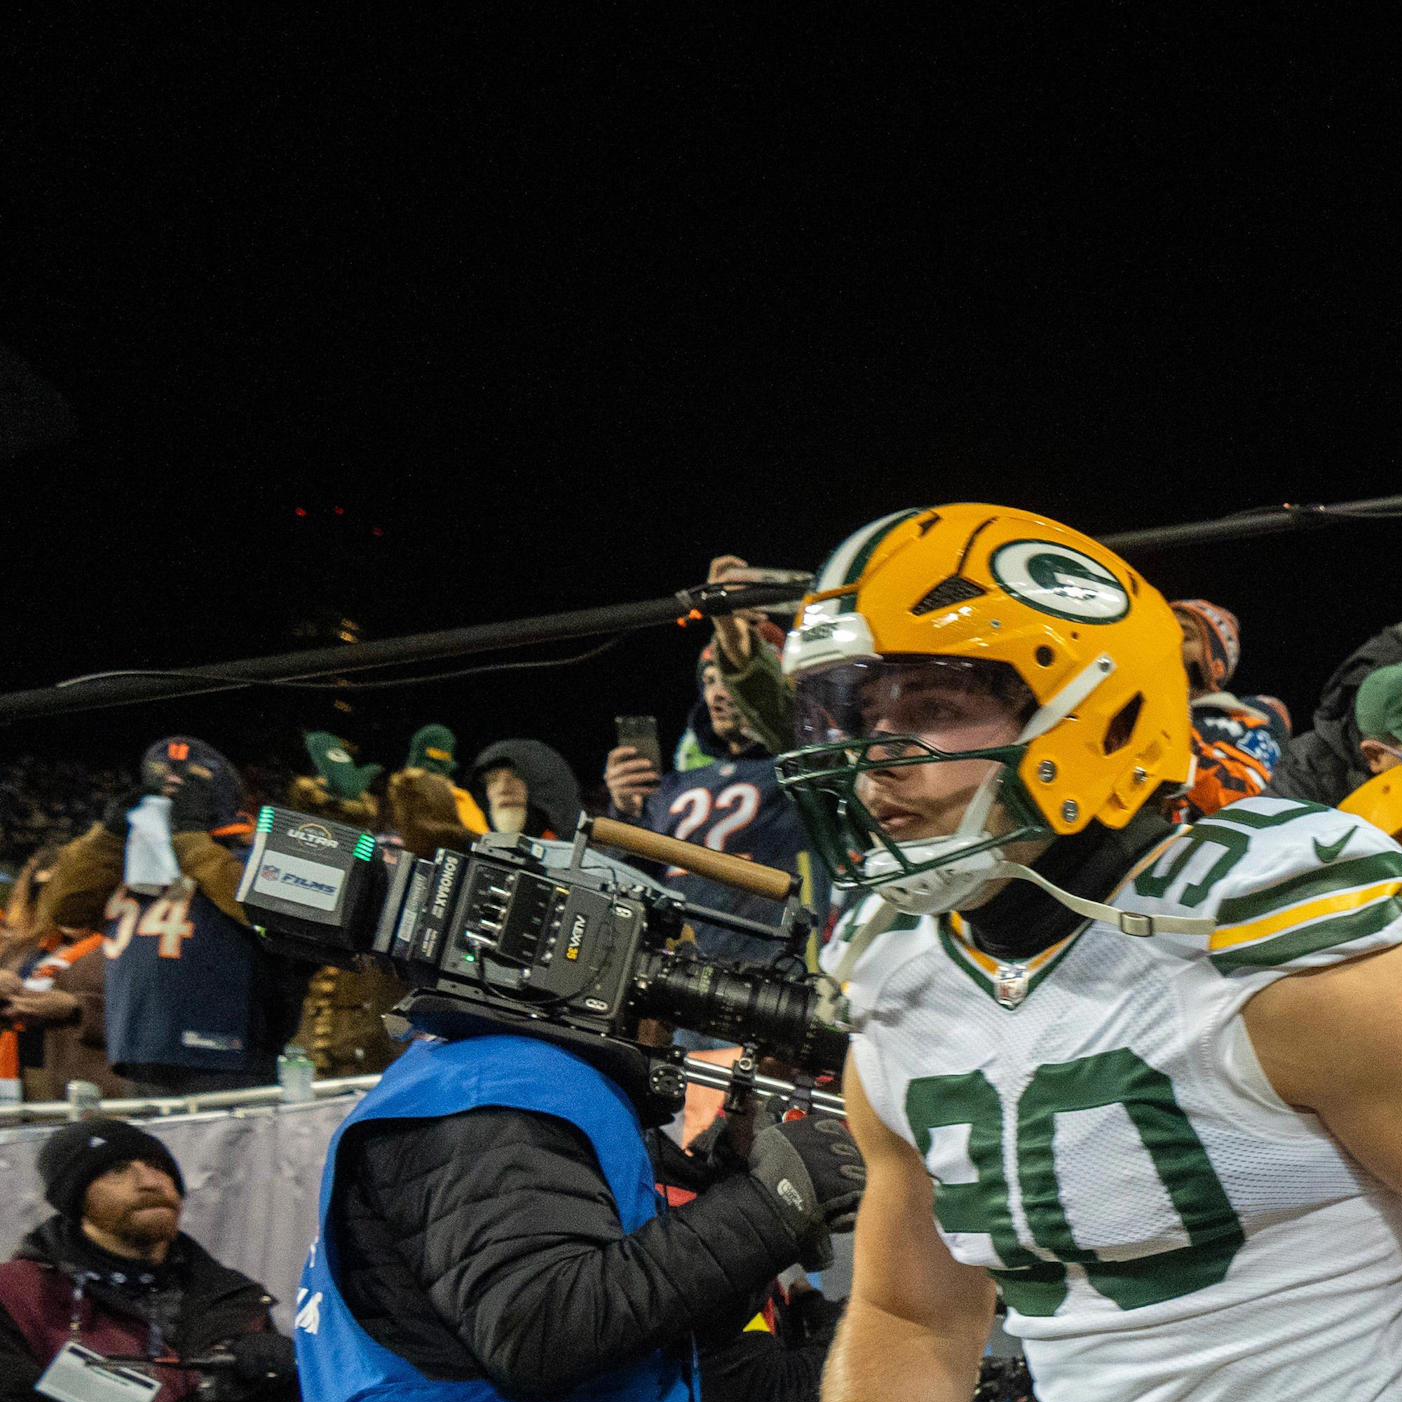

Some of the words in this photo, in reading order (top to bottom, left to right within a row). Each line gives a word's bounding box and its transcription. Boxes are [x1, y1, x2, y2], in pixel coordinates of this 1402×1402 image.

[287, 828, 339, 848] ULTRA
[281, 873, 338, 895] FILMS
[904, 1046, 1245, 1317] 90
